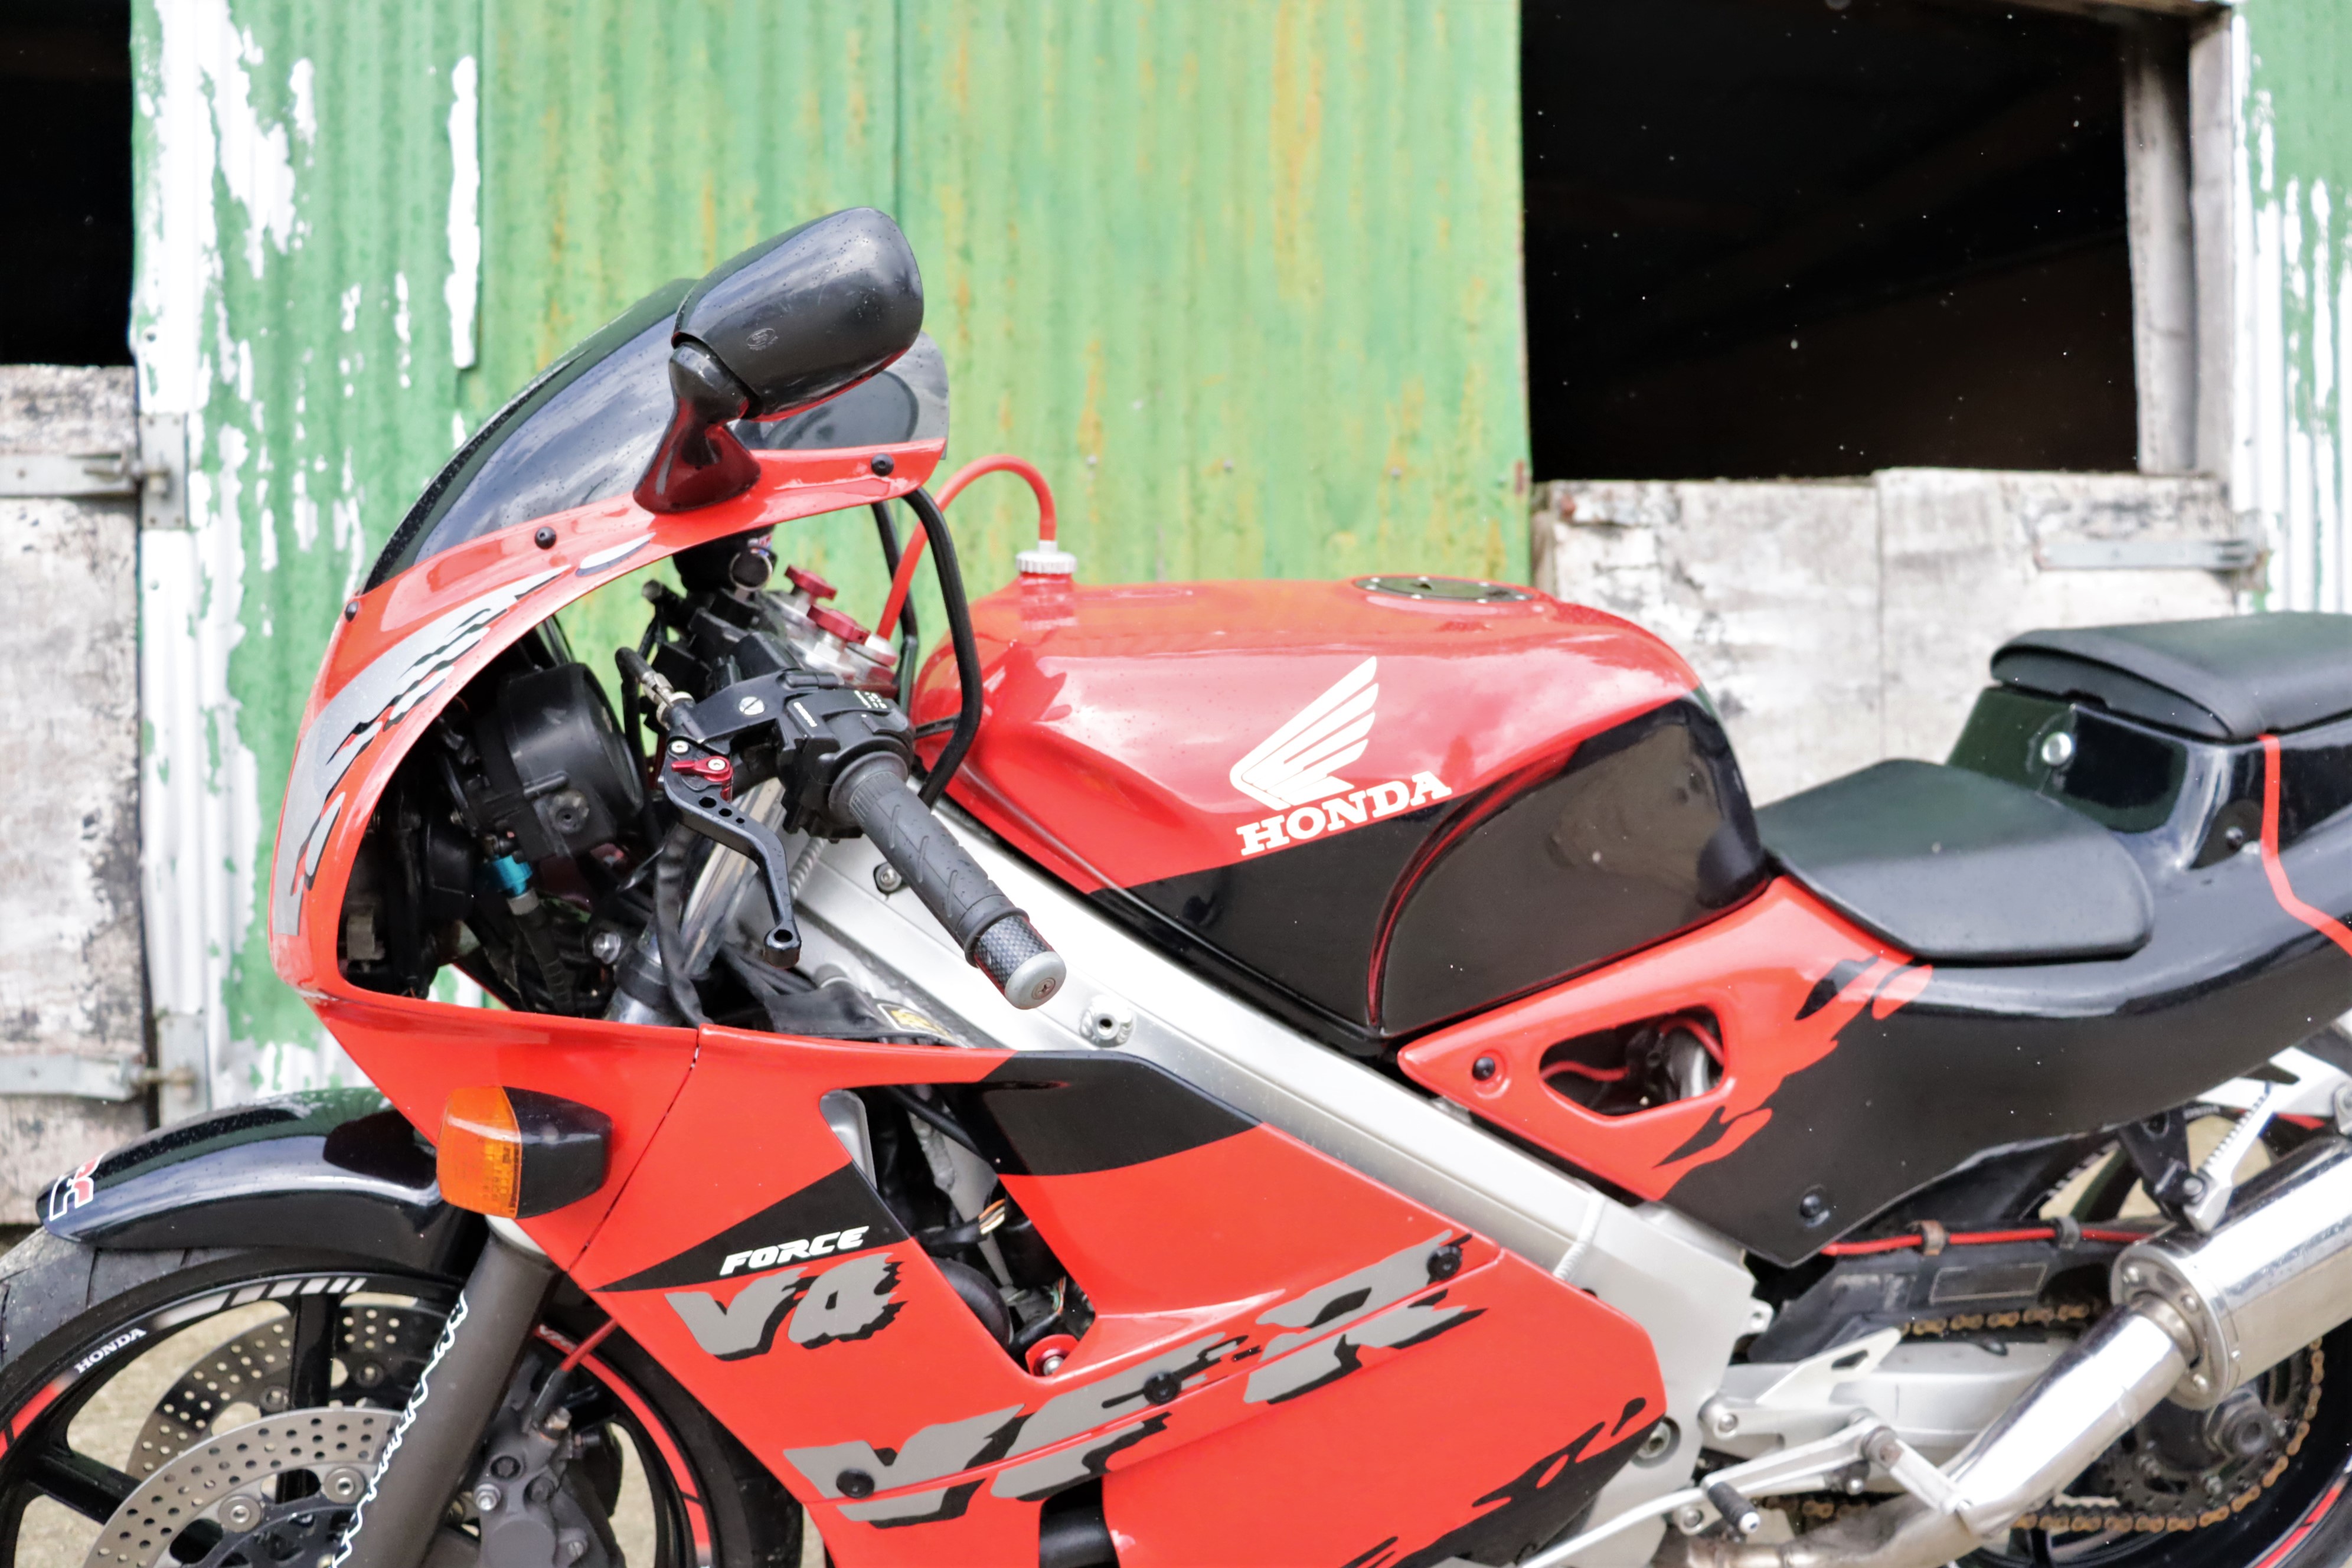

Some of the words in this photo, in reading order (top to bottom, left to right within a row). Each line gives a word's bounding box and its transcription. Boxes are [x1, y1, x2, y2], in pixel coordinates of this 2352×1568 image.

[1236, 771, 1452, 855] HONDA
[720, 1226, 869, 1276] FORCE
[664, 1253, 904, 1360] V4
[74, 1328, 146, 1374] HONDA
